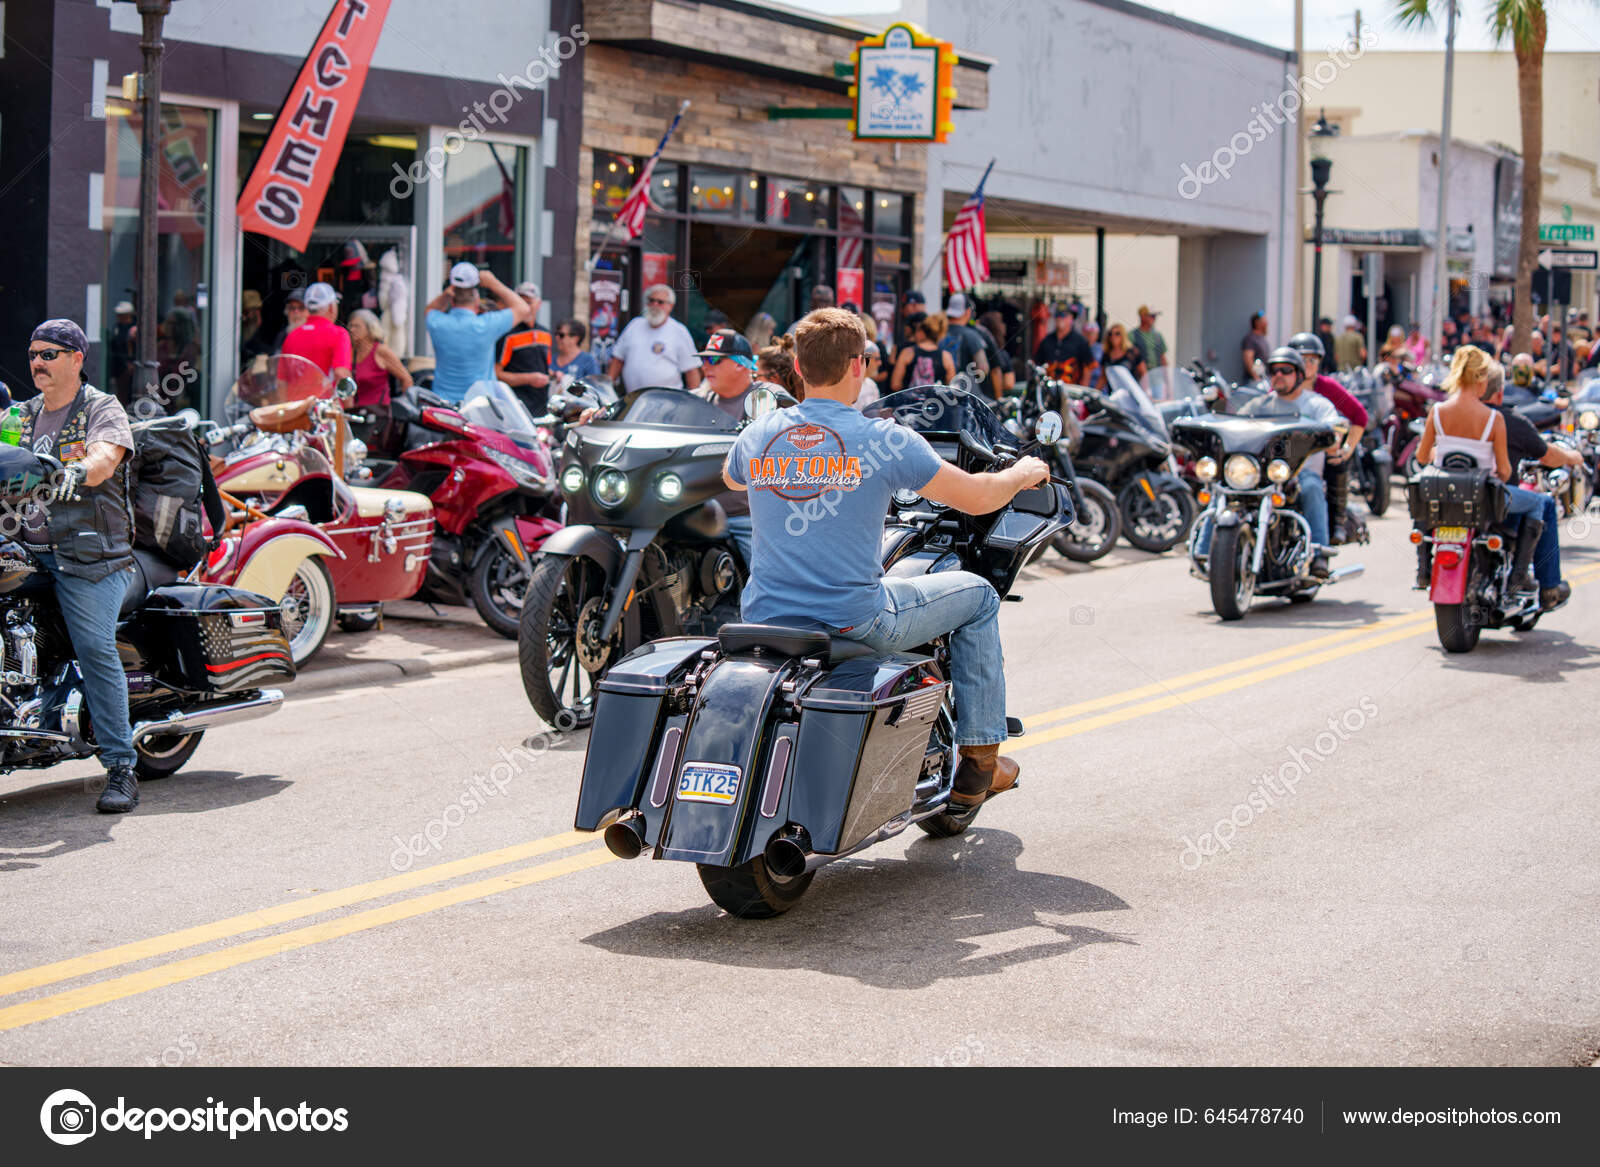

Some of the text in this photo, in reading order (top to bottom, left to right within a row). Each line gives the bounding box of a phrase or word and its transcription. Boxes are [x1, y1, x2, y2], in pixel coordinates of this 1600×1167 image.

[255, 0, 367, 230] TCHES
[749, 456, 862, 480] DAYTONA
[752, 470, 862, 489] Harley-Davidson
[680, 772, 739, 795] 5TK25
